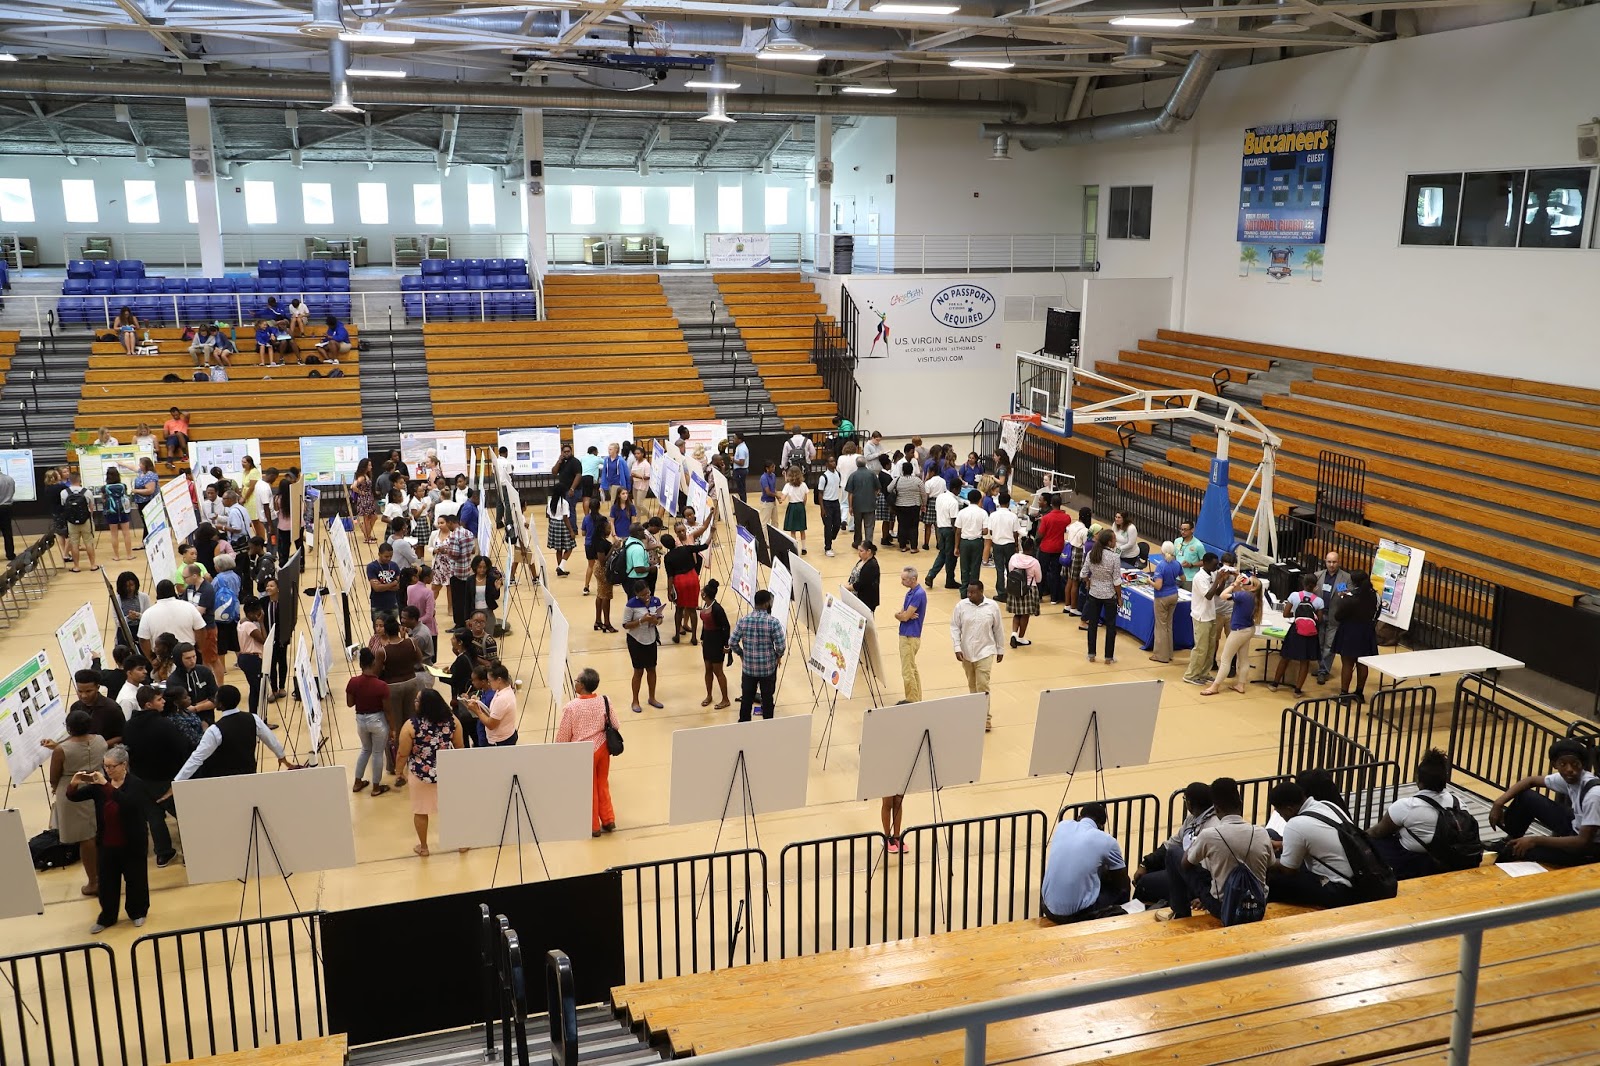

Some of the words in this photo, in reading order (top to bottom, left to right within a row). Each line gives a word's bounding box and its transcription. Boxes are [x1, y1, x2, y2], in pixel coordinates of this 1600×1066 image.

[1244, 130, 1328, 155] Buccaneers
[1244, 158, 1268, 166] BUCCANEERS
[1307, 154, 1324, 162] GUEST
[936, 294, 949, 305] NO
[950, 288, 992, 304] PASSPORT
[943, 312, 983, 325] REQUIRED
[911, 336, 942, 345] VIRGIN
[945, 336, 983, 344] ISLANDS
